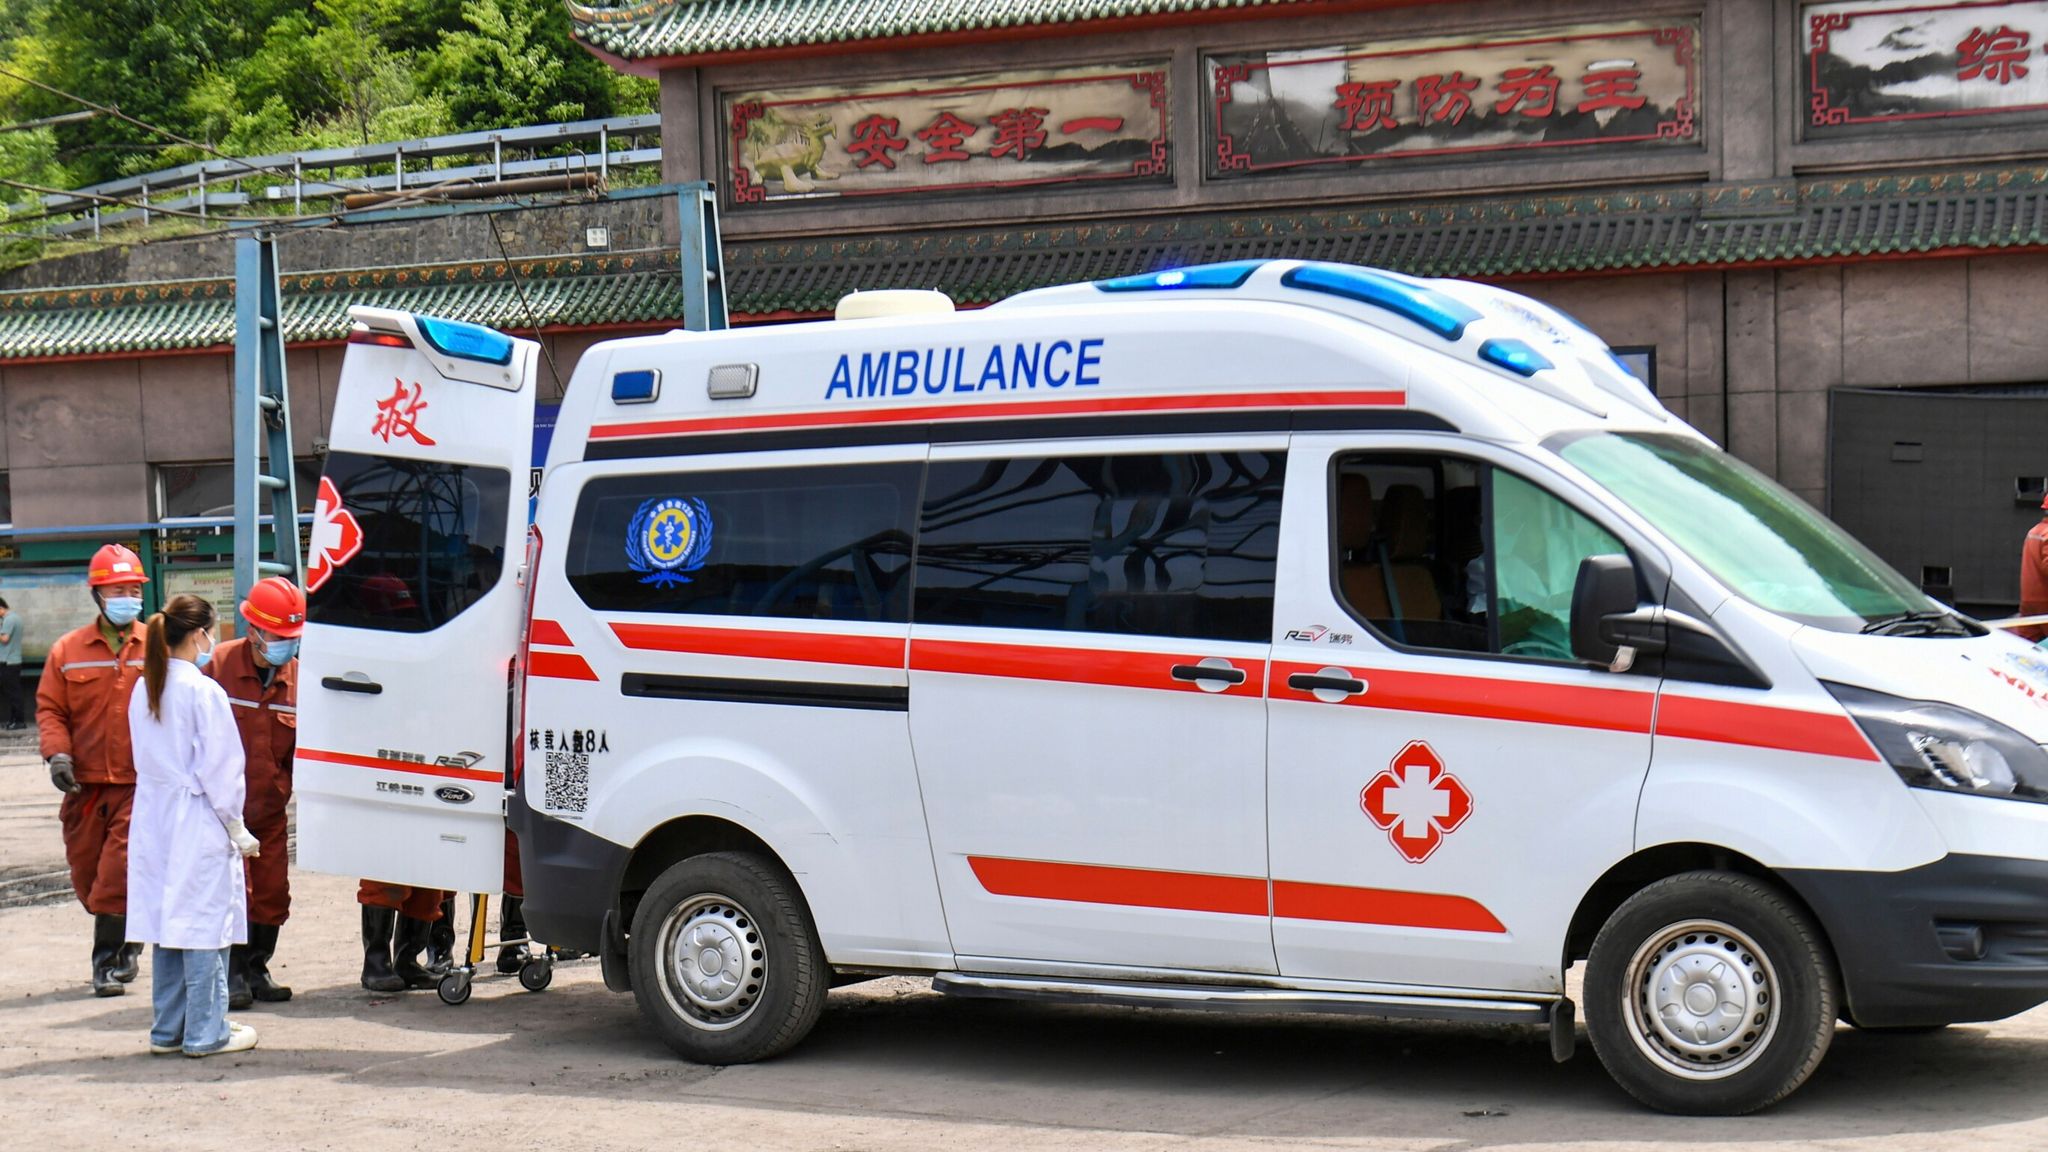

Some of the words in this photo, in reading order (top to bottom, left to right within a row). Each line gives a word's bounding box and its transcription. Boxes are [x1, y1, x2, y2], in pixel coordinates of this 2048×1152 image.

[1956, 25, 2048, 85] 综
[1335, 59, 1648, 131] 预防为主
[848, 107, 1125, 169] 安全第一
[825, 338, 1104, 399] AMBULANCE
[372, 377, 437, 446] 救
[1284, 624, 1330, 642] REV
[434, 751, 485, 769] REV
